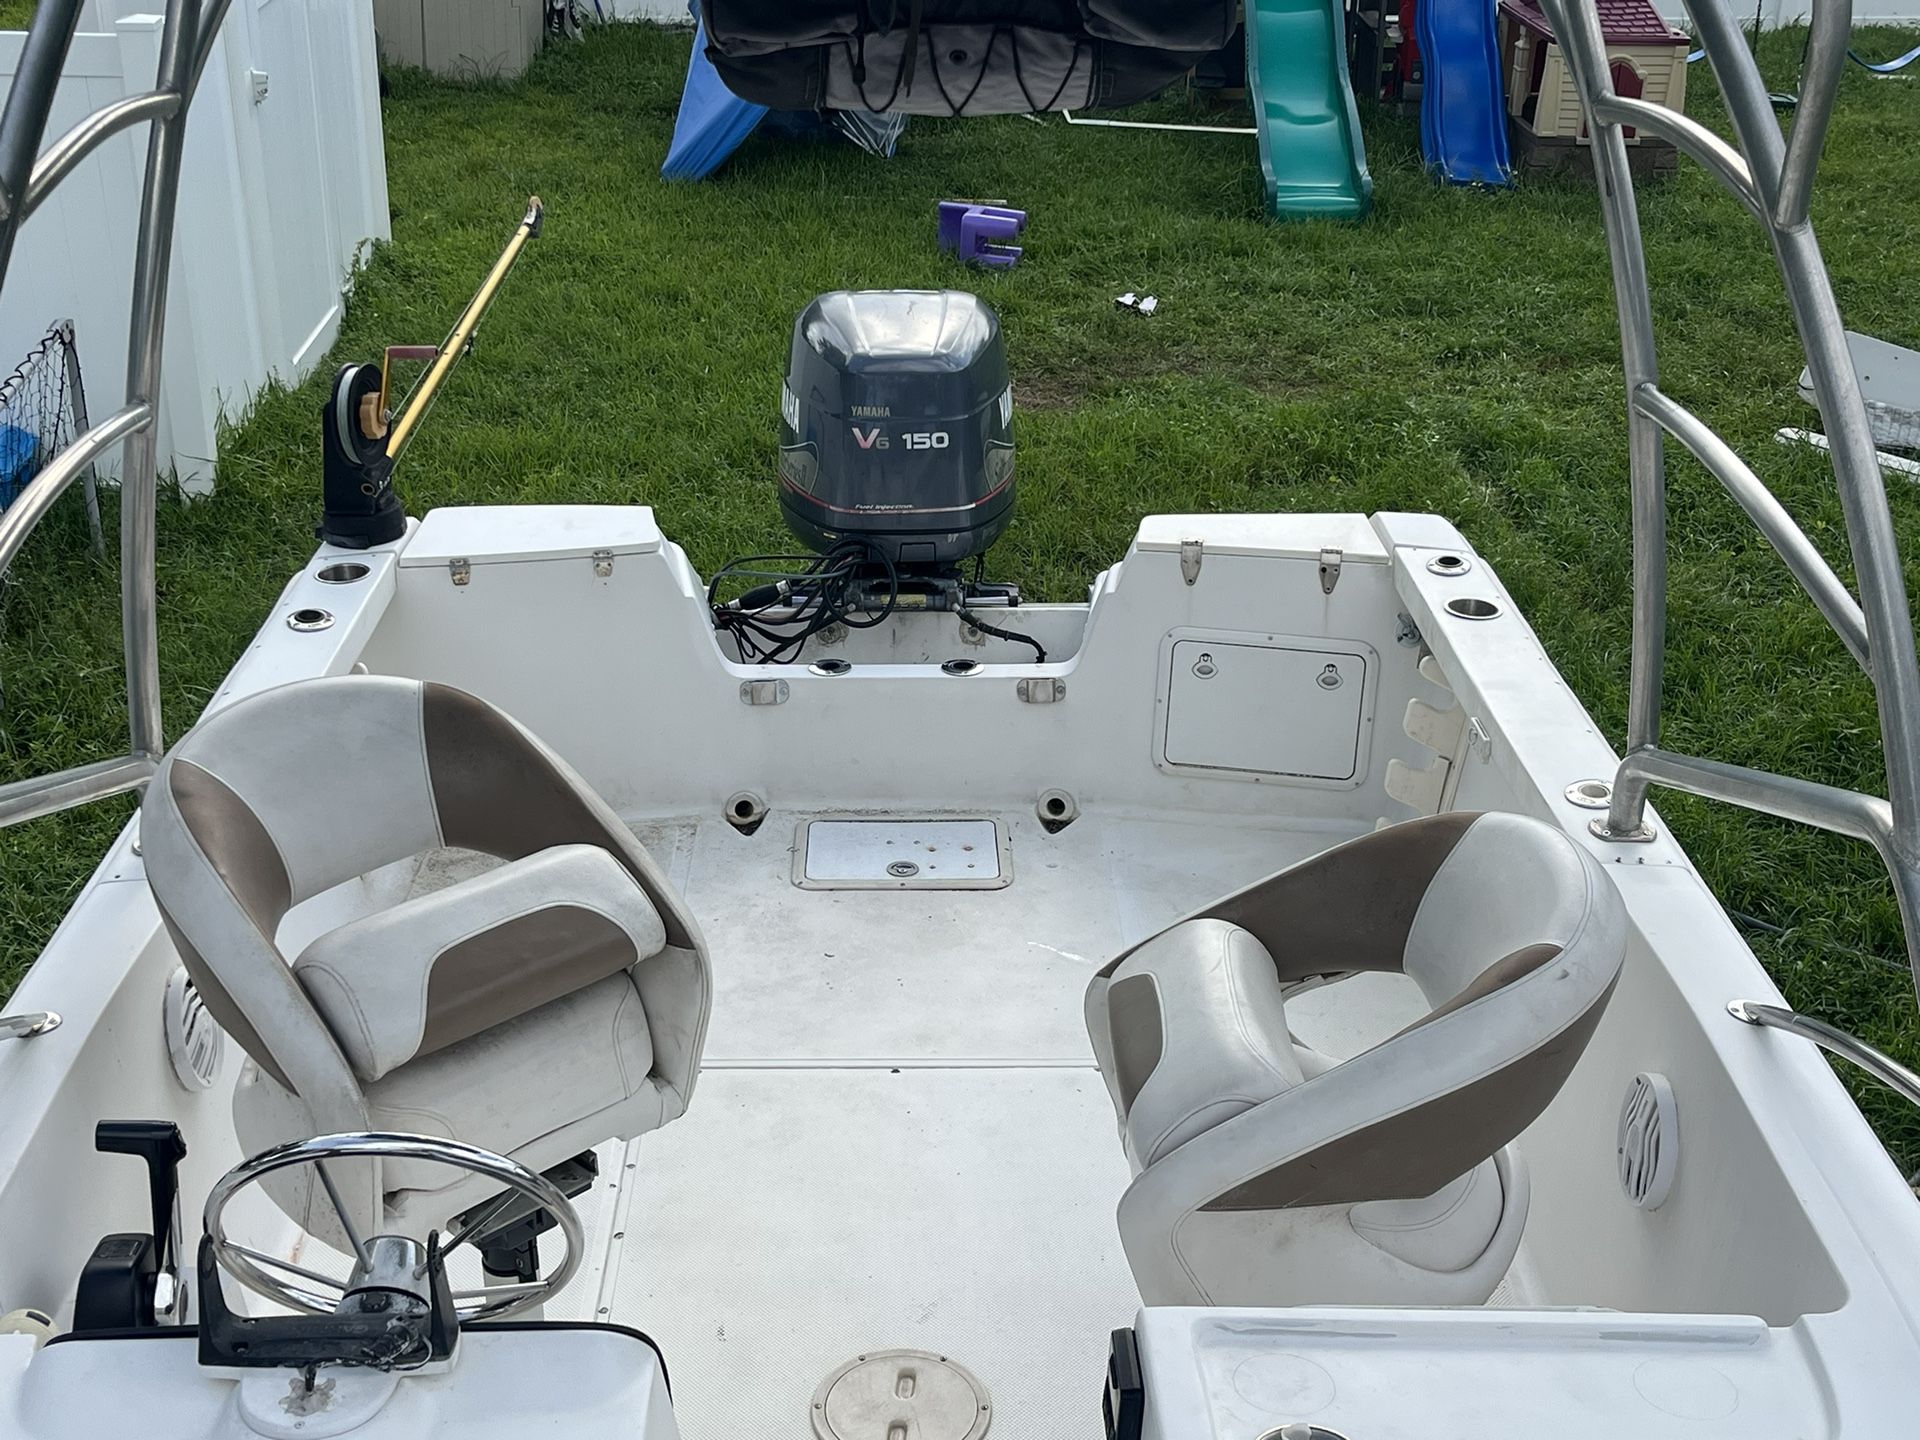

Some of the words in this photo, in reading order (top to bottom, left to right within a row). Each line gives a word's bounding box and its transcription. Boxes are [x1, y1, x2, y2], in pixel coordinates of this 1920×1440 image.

[851, 405, 891, 417] YAMAHA
[851, 427, 890, 449] V6
[902, 431, 949, 450] 150
